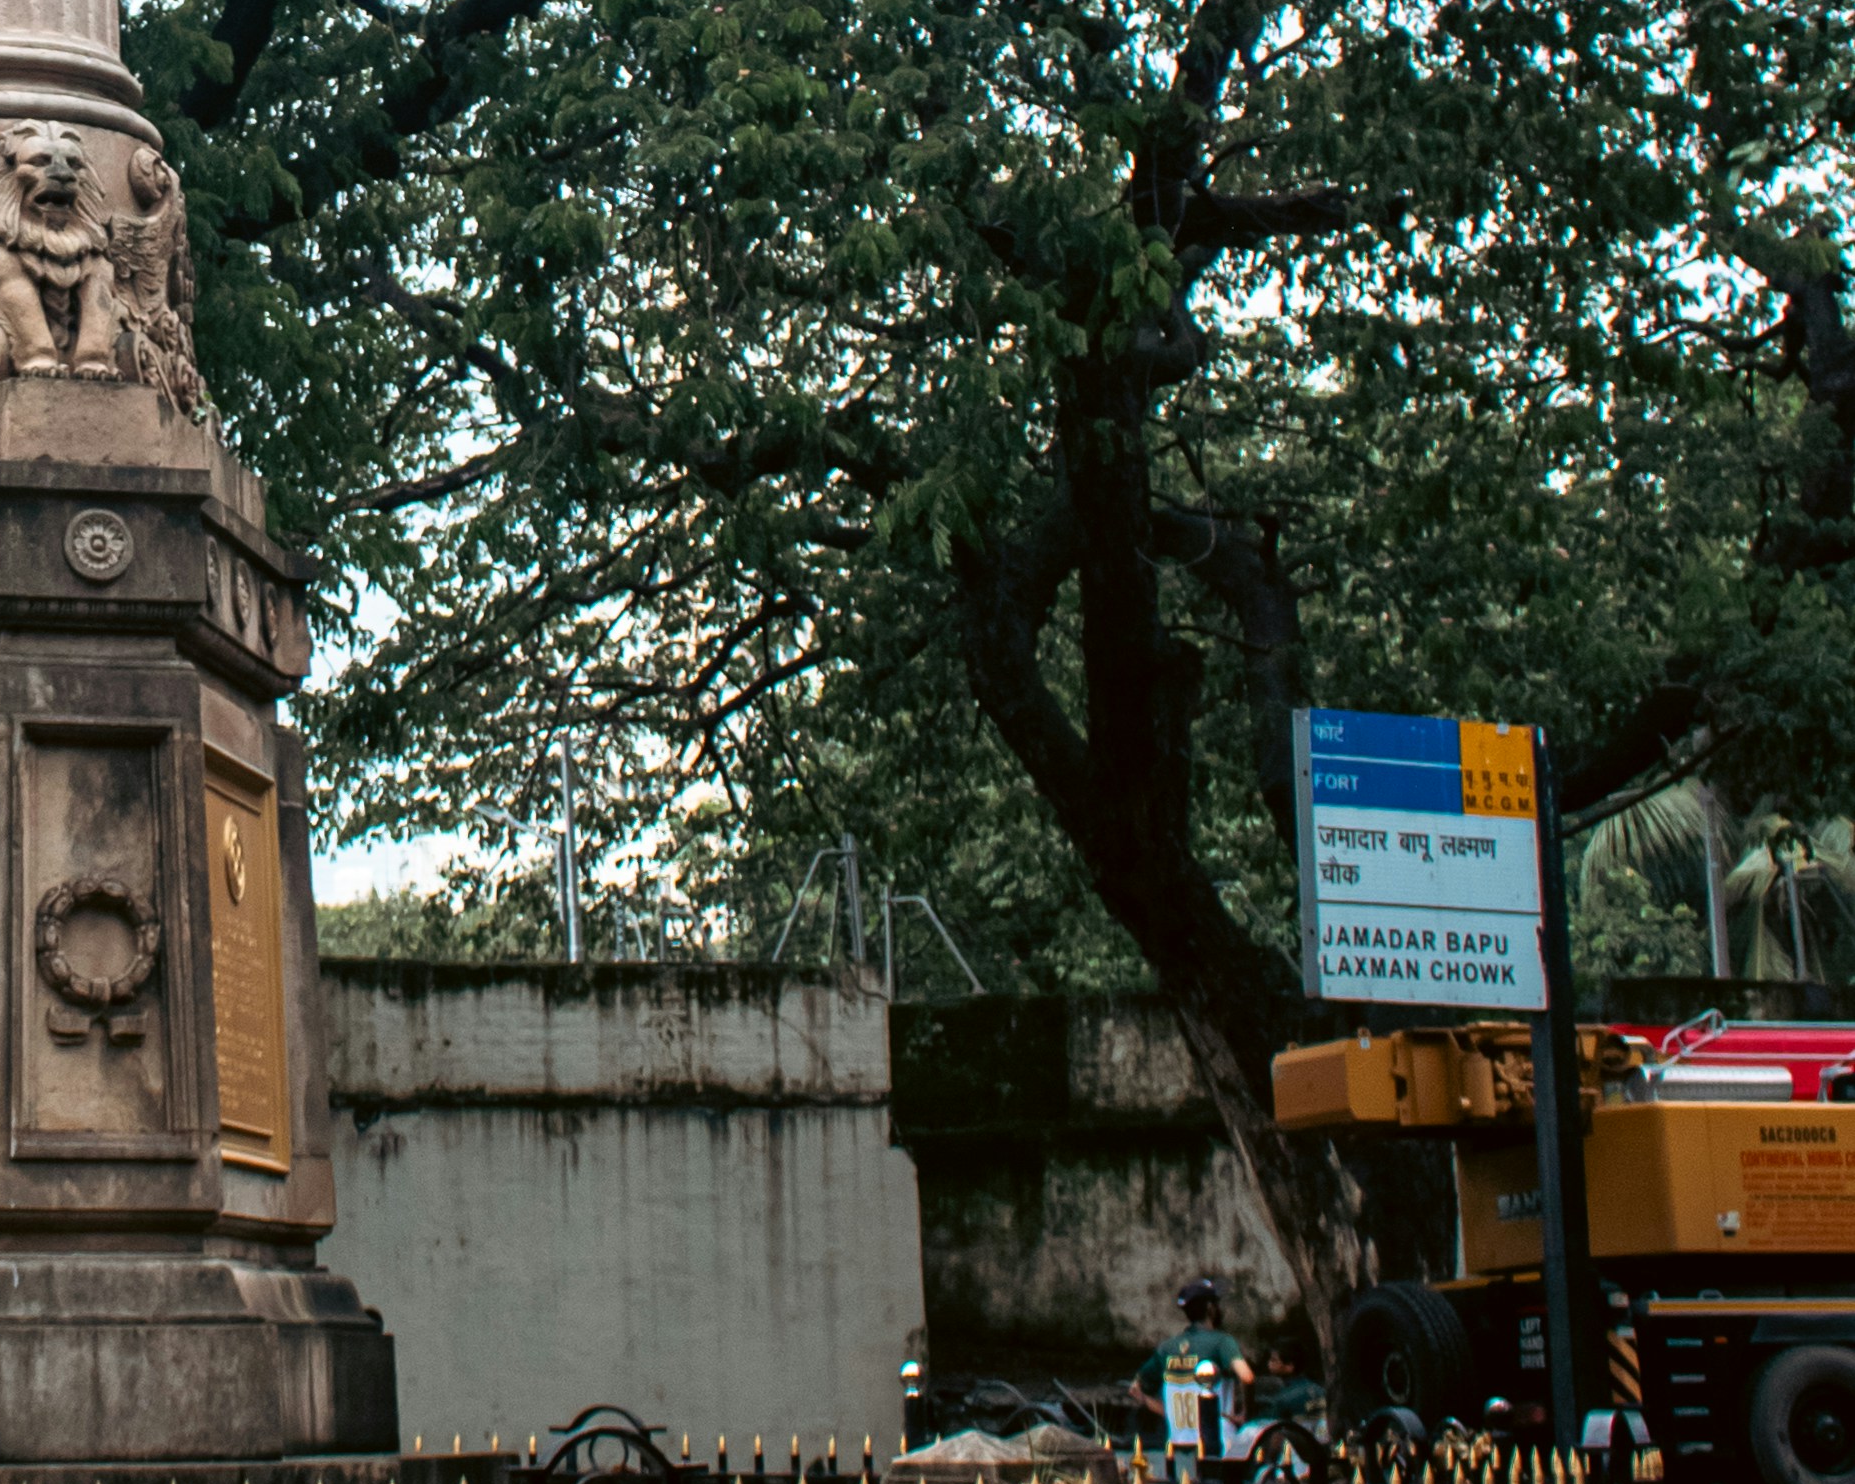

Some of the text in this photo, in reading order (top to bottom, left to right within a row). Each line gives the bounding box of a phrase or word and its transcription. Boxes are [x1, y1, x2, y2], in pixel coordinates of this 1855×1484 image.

[1313, 772, 1359, 792] FORT
[1318, 824, 1497, 862] जमादार बापू लक्ष्मण
[1318, 856, 1361, 885] चौक
[1322, 924, 1509, 956] JAMADAR BAPU
[1322, 954, 1516, 985] LAXMAN CHOWK
